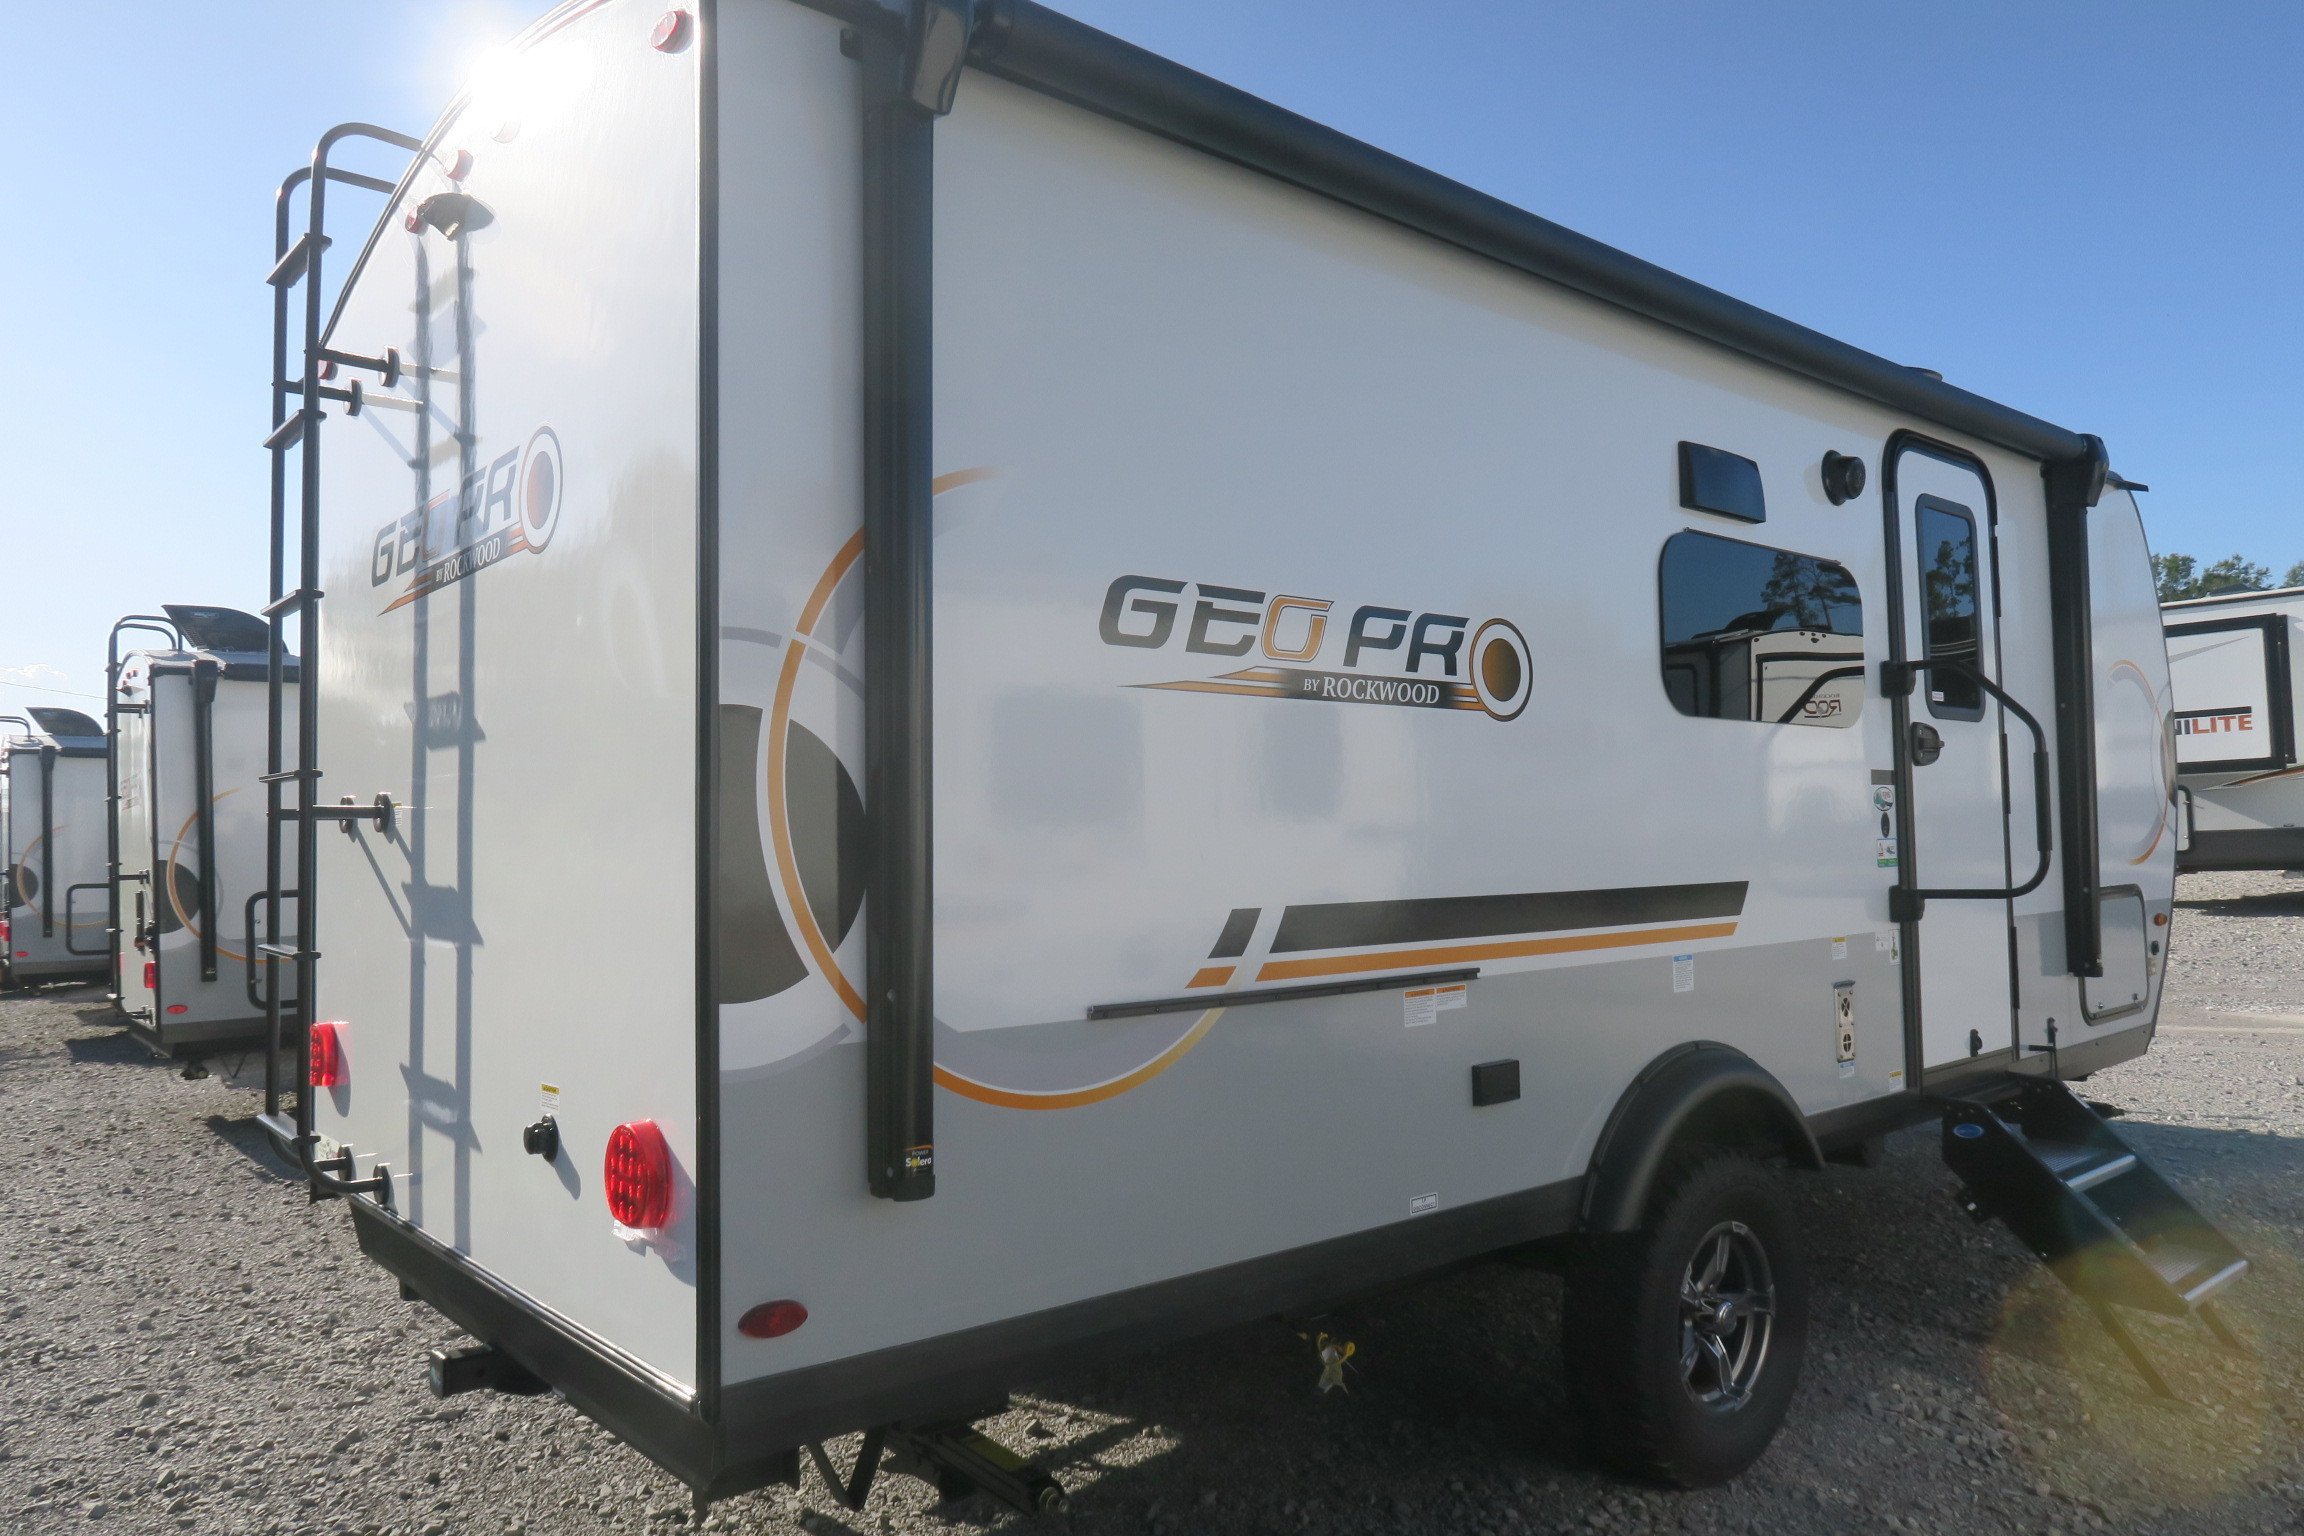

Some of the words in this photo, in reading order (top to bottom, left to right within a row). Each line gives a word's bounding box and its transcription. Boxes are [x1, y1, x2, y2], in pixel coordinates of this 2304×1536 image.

[371, 488, 451, 588] GEO
[443, 537, 501, 583] ROCKWOOD
[1099, 574, 1335, 663] GEO
[1303, 678, 1320, 692] BY
[1322, 676, 1440, 704] ROCKWOOD
